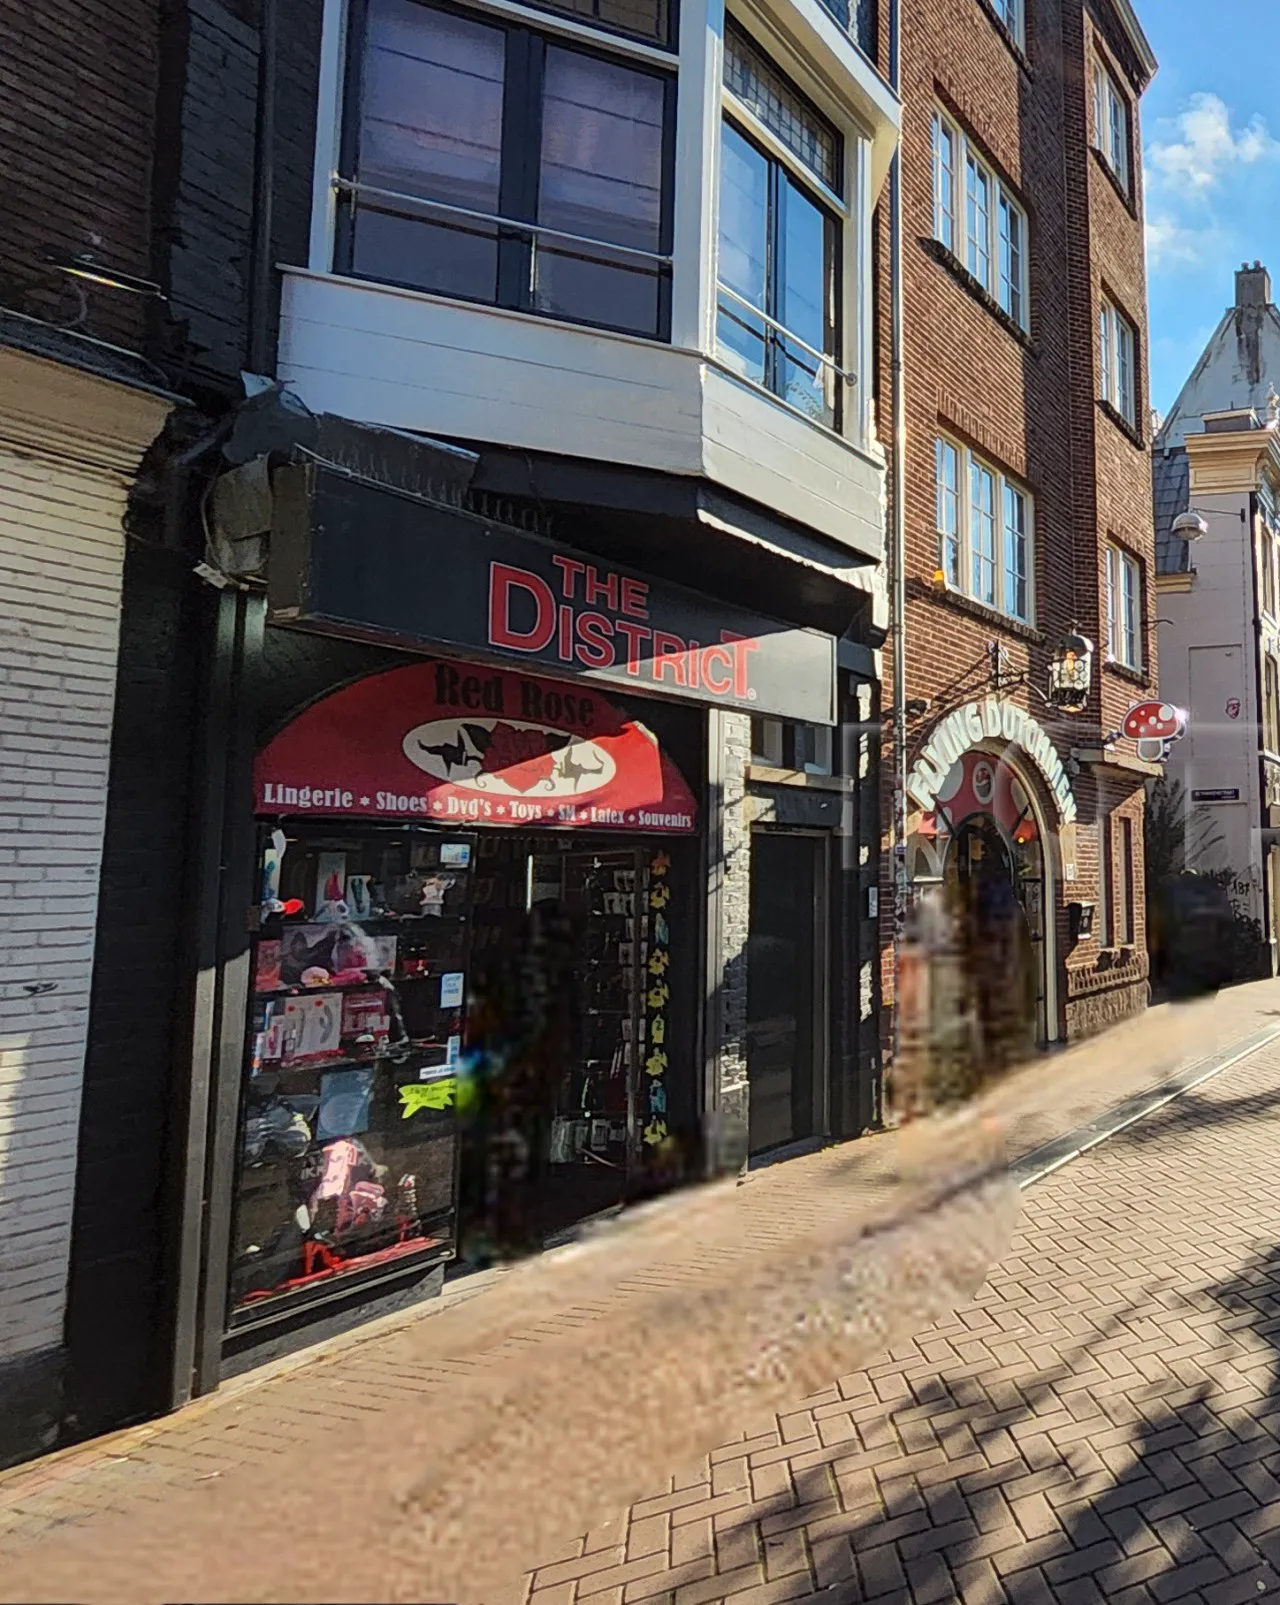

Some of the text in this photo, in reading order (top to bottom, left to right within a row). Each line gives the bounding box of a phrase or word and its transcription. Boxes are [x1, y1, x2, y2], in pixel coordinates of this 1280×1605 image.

[553, 554, 649, 620] THE
[488, 561, 760, 699] DISTRICT
[434, 663, 595, 727] Red Rose
[907, 699, 1078, 825] FLYING DUTCHMEN
[264, 783, 353, 808] Lingerie
[376, 791, 428, 812] Shoes
[509, 800, 543, 820] Toys
[558, 804, 576, 822] SM
[591, 807, 625, 824] Latex
[638, 810, 692, 828] Souvenirs
